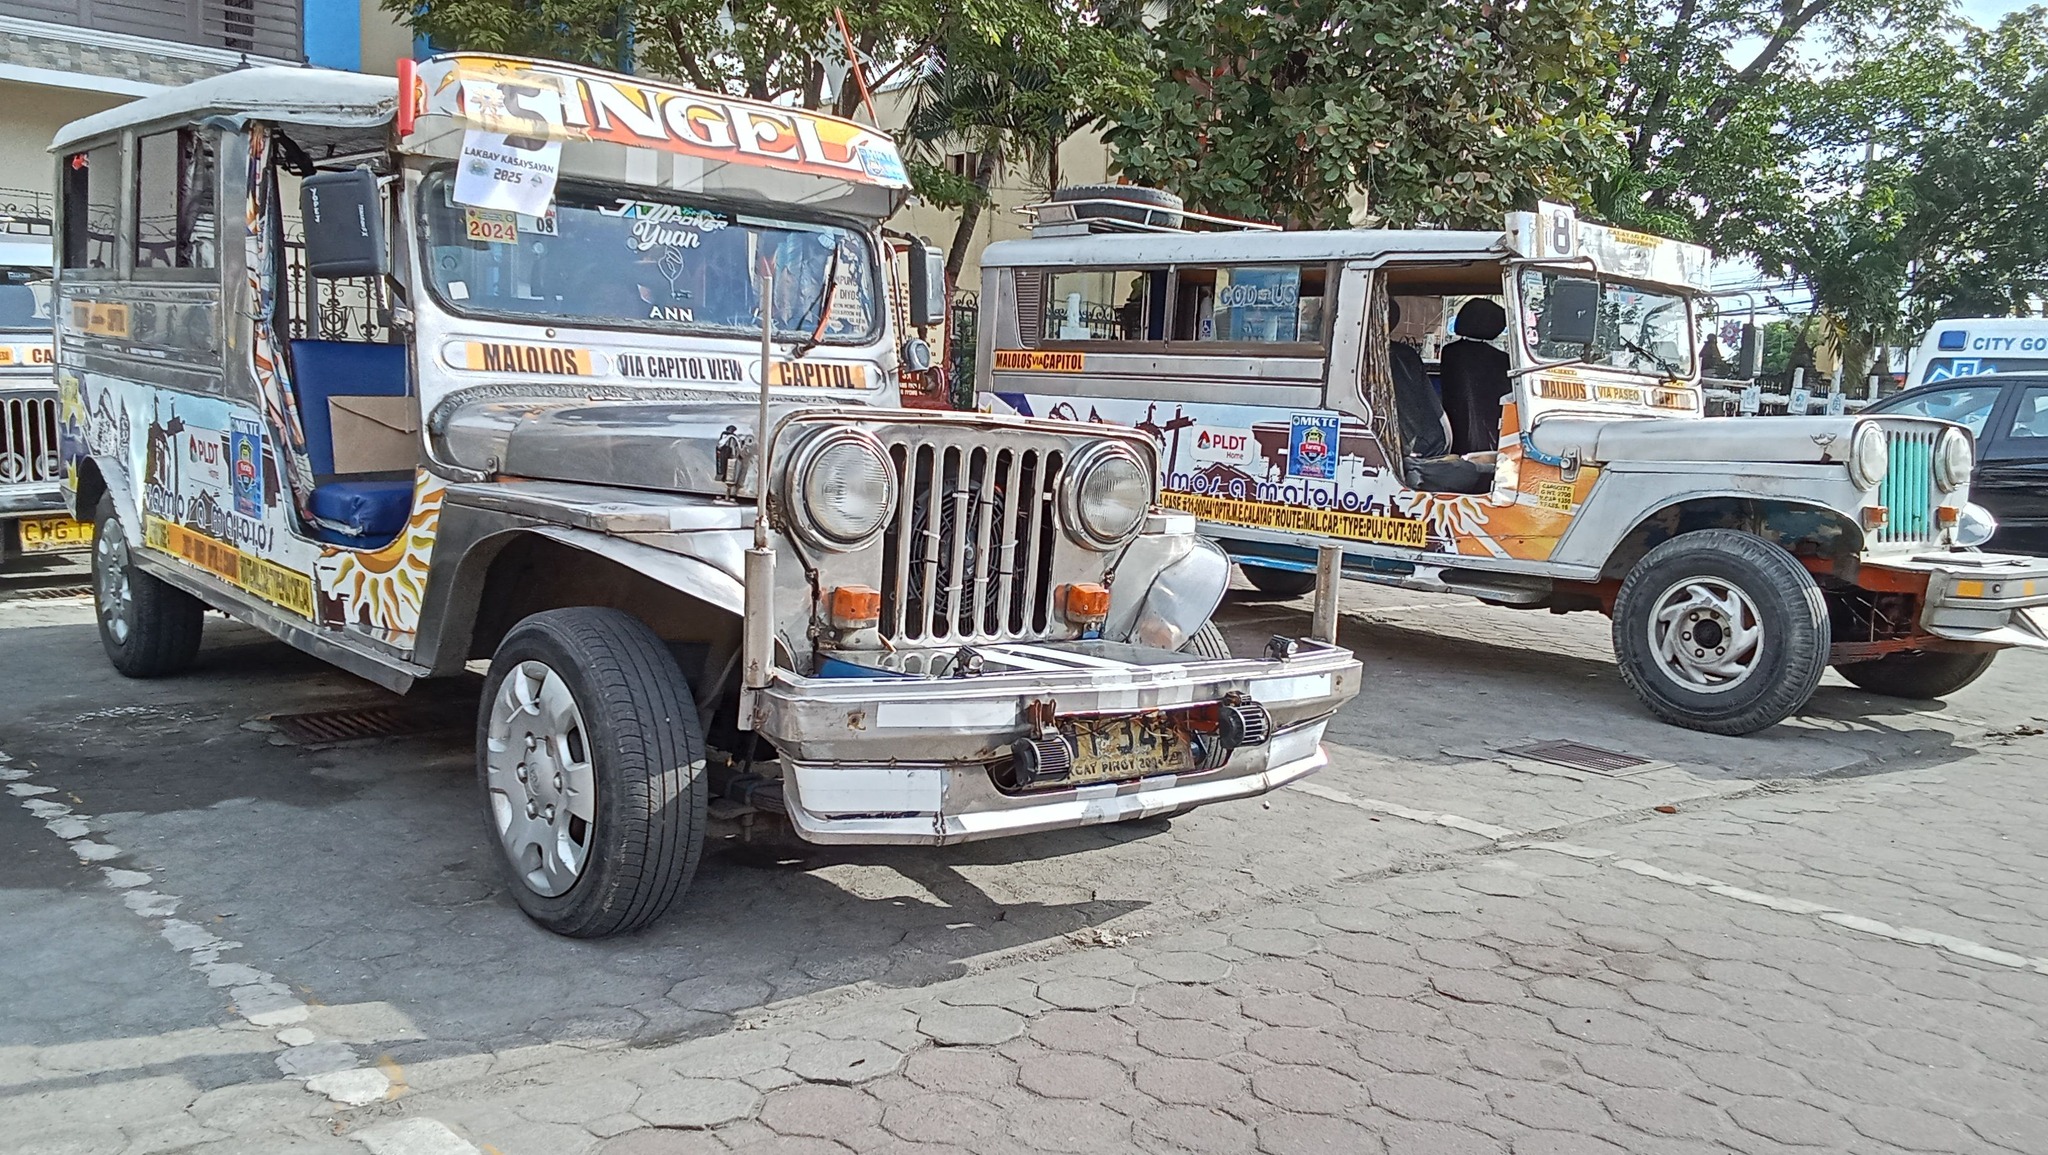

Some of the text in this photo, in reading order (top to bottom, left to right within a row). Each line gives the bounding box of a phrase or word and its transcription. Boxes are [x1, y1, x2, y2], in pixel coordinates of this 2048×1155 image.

[464, 146, 554, 174] LAKBAY KASAYSAYAN
[493, 167, 523, 184] 2025
[470, 220, 515, 241] 2024
[536, 216, 554, 233] 08
[632, 219, 701, 251] Yuan
[1553, 208, 1571, 255] 8
[1219, 284, 1257, 306] GOD
[1271, 283, 1298, 306] US
[649, 305, 694, 321] ANN
[1972, 337, 2016, 350] CITY
[482, 342, 579, 376] MALOLOS
[619, 355, 743, 381] VIA CAPITOL VIEW
[996, 352, 1032, 369] MALOLOS
[1043, 353, 1082, 370] CAPITOL
[779, 361, 856, 389] CAPITOL
[1540, 379, 1587, 400] MALOLOS
[1597, 386, 1611, 399] VIA
[1614, 387, 1640, 401] PASEO
[1300, 416, 1337, 428] MKTC
[198, 439, 219, 466] PLDT
[1212, 434, 1247, 451] PLDT
[1226, 451, 1244, 460] Home
[1160, 470, 1375, 511] mos a malolos
[1163, 493, 1182, 510] CASE
[24, 521, 68, 542] CWG
